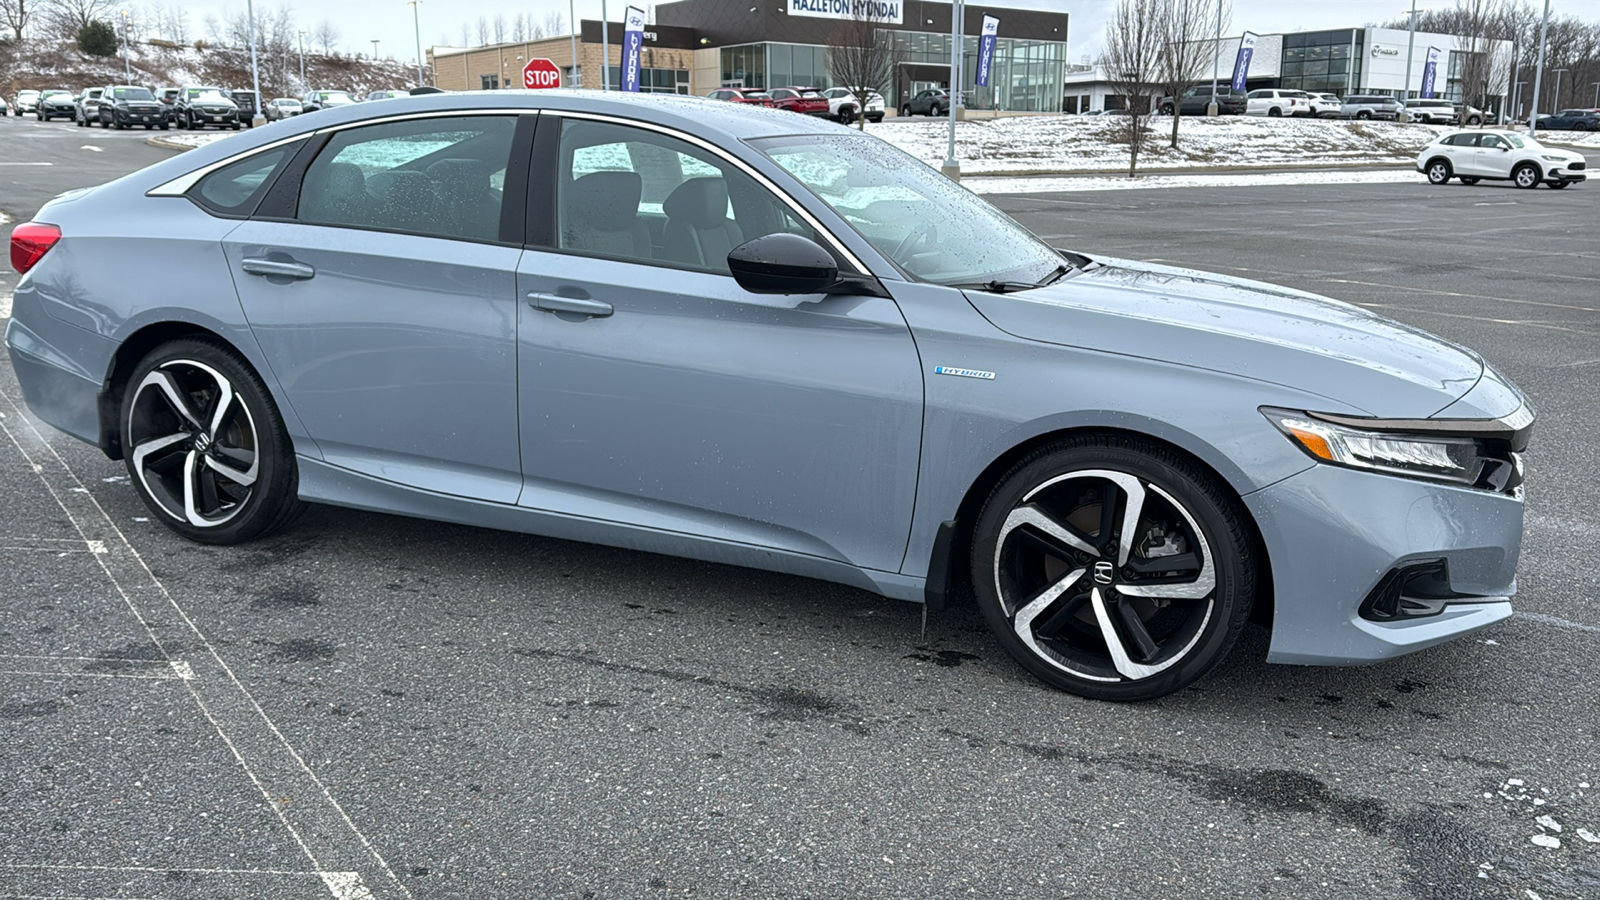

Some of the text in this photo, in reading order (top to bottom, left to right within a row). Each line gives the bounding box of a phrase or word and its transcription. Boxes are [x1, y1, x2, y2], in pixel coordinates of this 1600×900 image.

[793, 0, 898, 18] HAZLETON HYUNDAI
[627, 33, 639, 90] HYUNDAI
[981, 36, 991, 84] HYUNDAI
[525, 70, 559, 86] STOP
[943, 368, 992, 378] HYBRID
